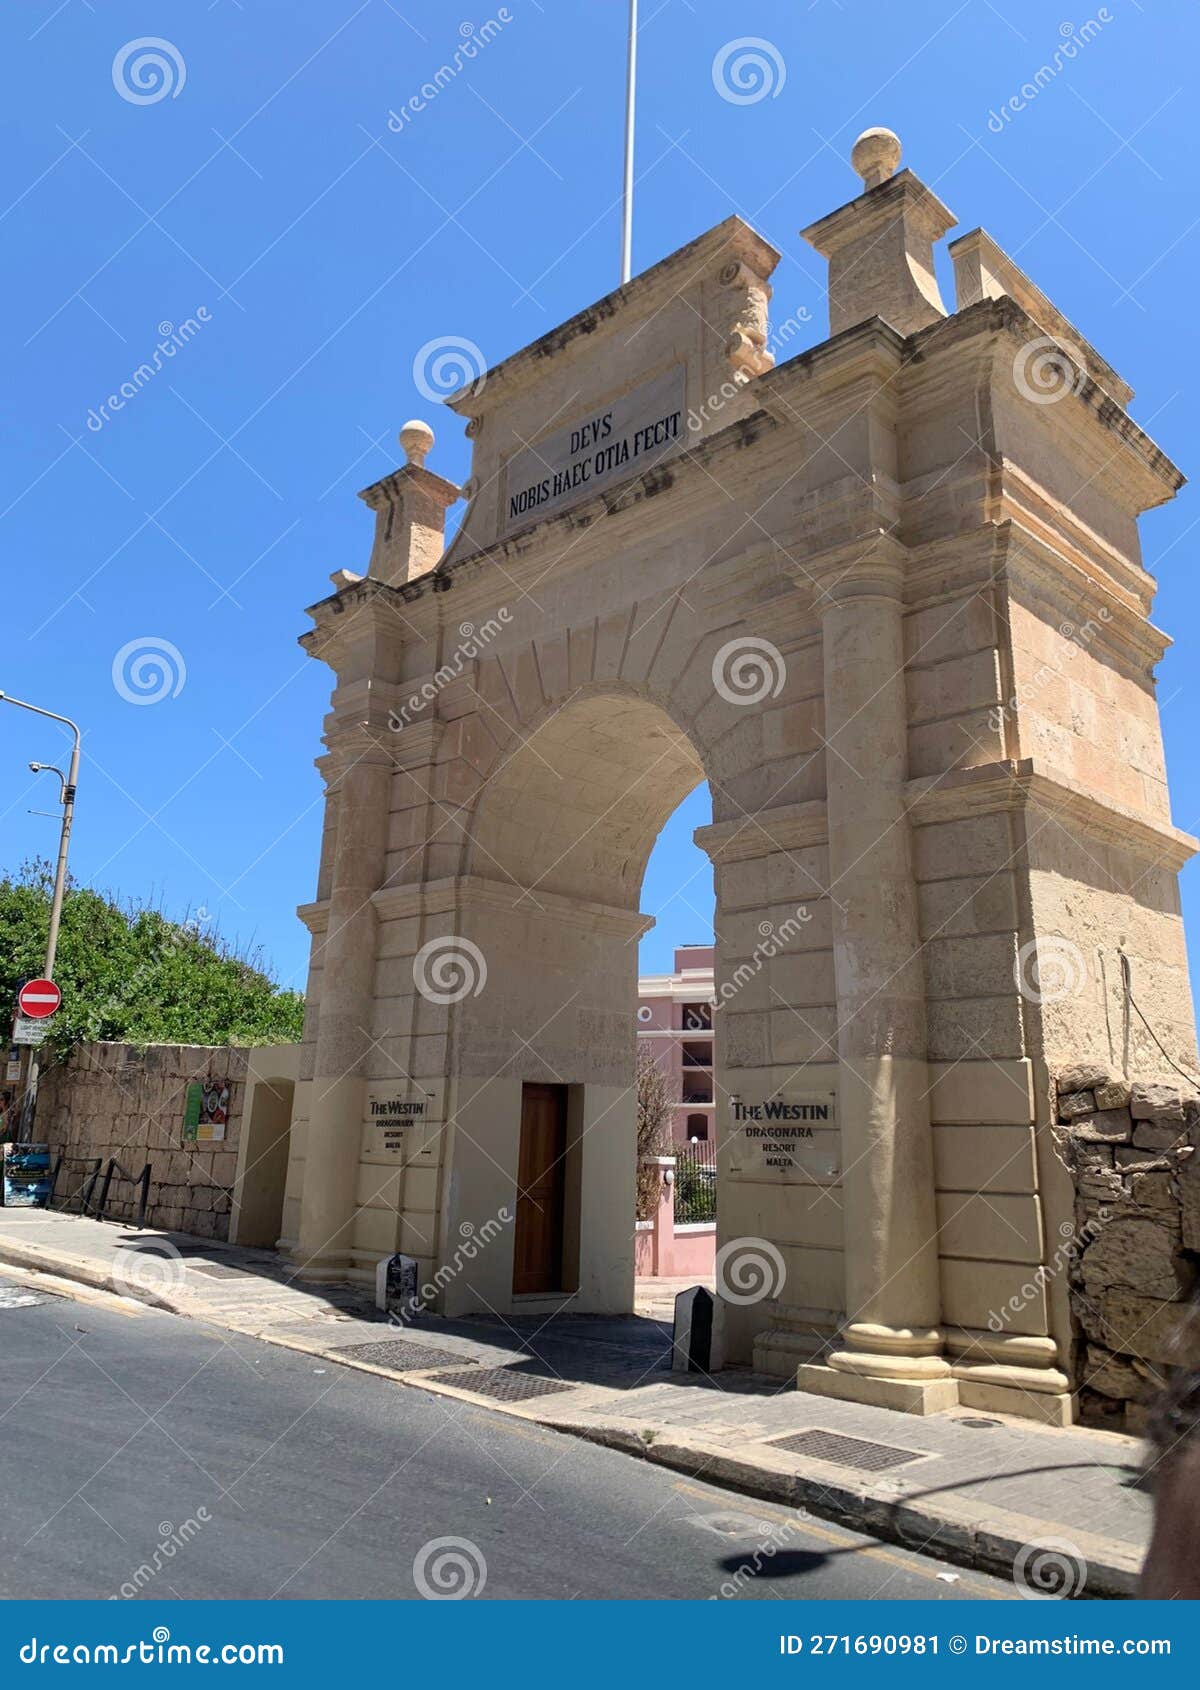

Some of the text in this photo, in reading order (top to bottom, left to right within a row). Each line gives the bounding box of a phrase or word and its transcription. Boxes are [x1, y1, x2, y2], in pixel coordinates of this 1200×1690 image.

[570, 411, 613, 455] DEVS
[509, 411, 681, 519] NOBIS HAEC OTIA FECIT
[387, 1100, 424, 1115] WESTIN
[732, 1101, 828, 1120] THE WESTIN
[745, 1127, 813, 1138] DRAGONARA
[762, 1143, 796, 1153] RESORT
[766, 1158, 793, 1167] MALTA
